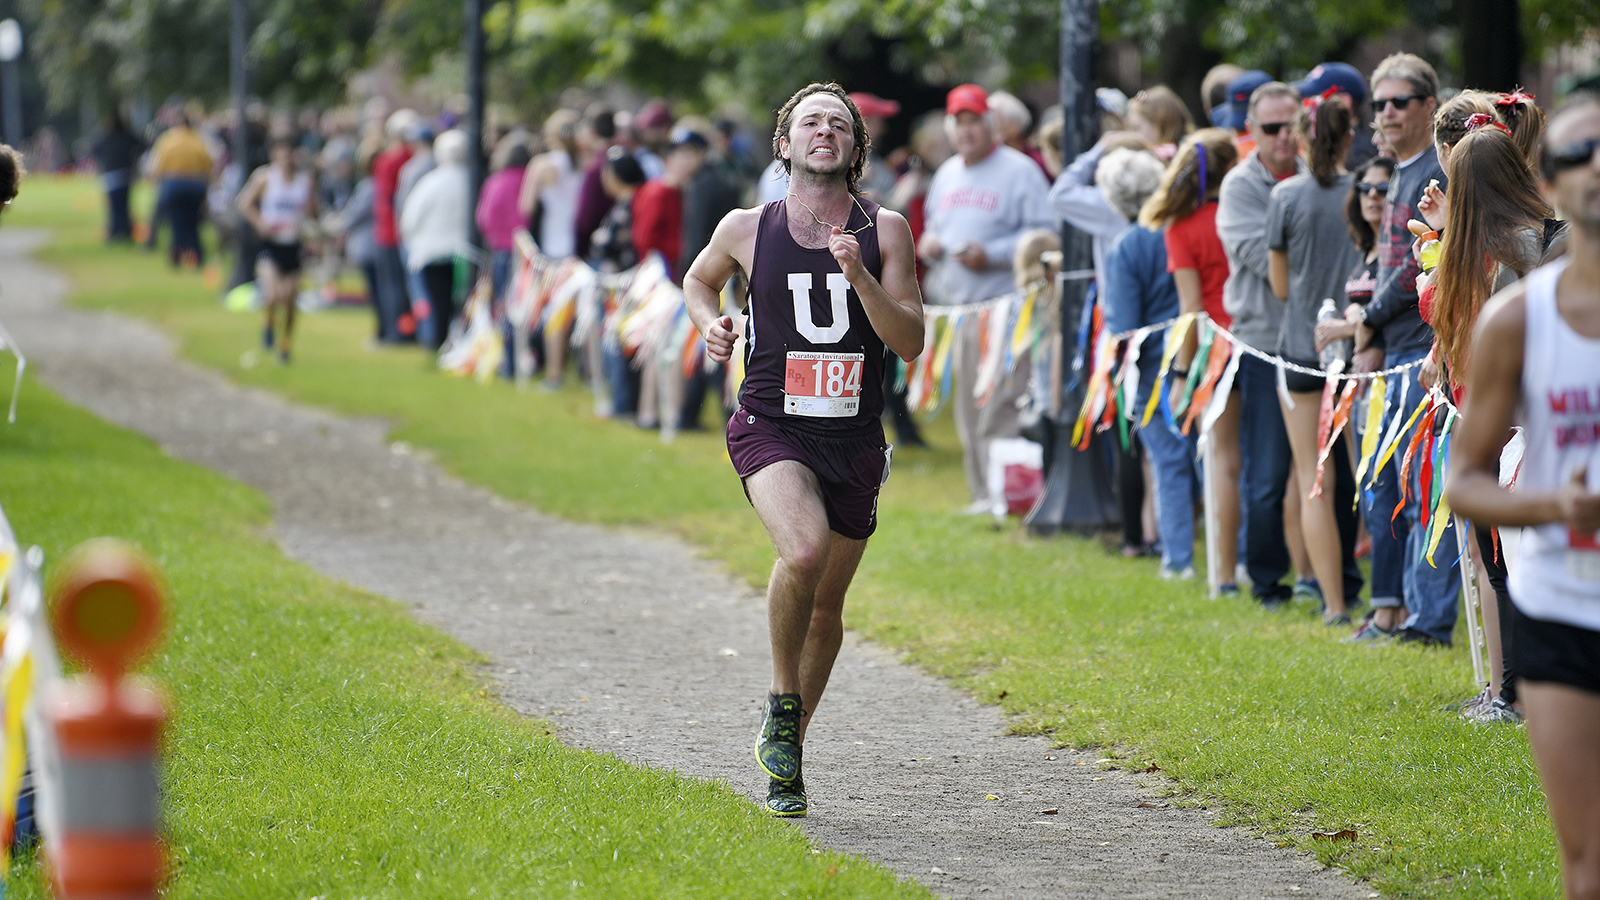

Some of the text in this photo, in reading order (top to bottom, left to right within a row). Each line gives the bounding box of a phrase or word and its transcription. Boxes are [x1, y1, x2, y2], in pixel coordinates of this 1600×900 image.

[787, 273, 850, 344] U
[792, 352, 860, 361] Saratoga Invitational
[787, 368, 806, 387] RPI
[811, 360, 861, 397] 184
